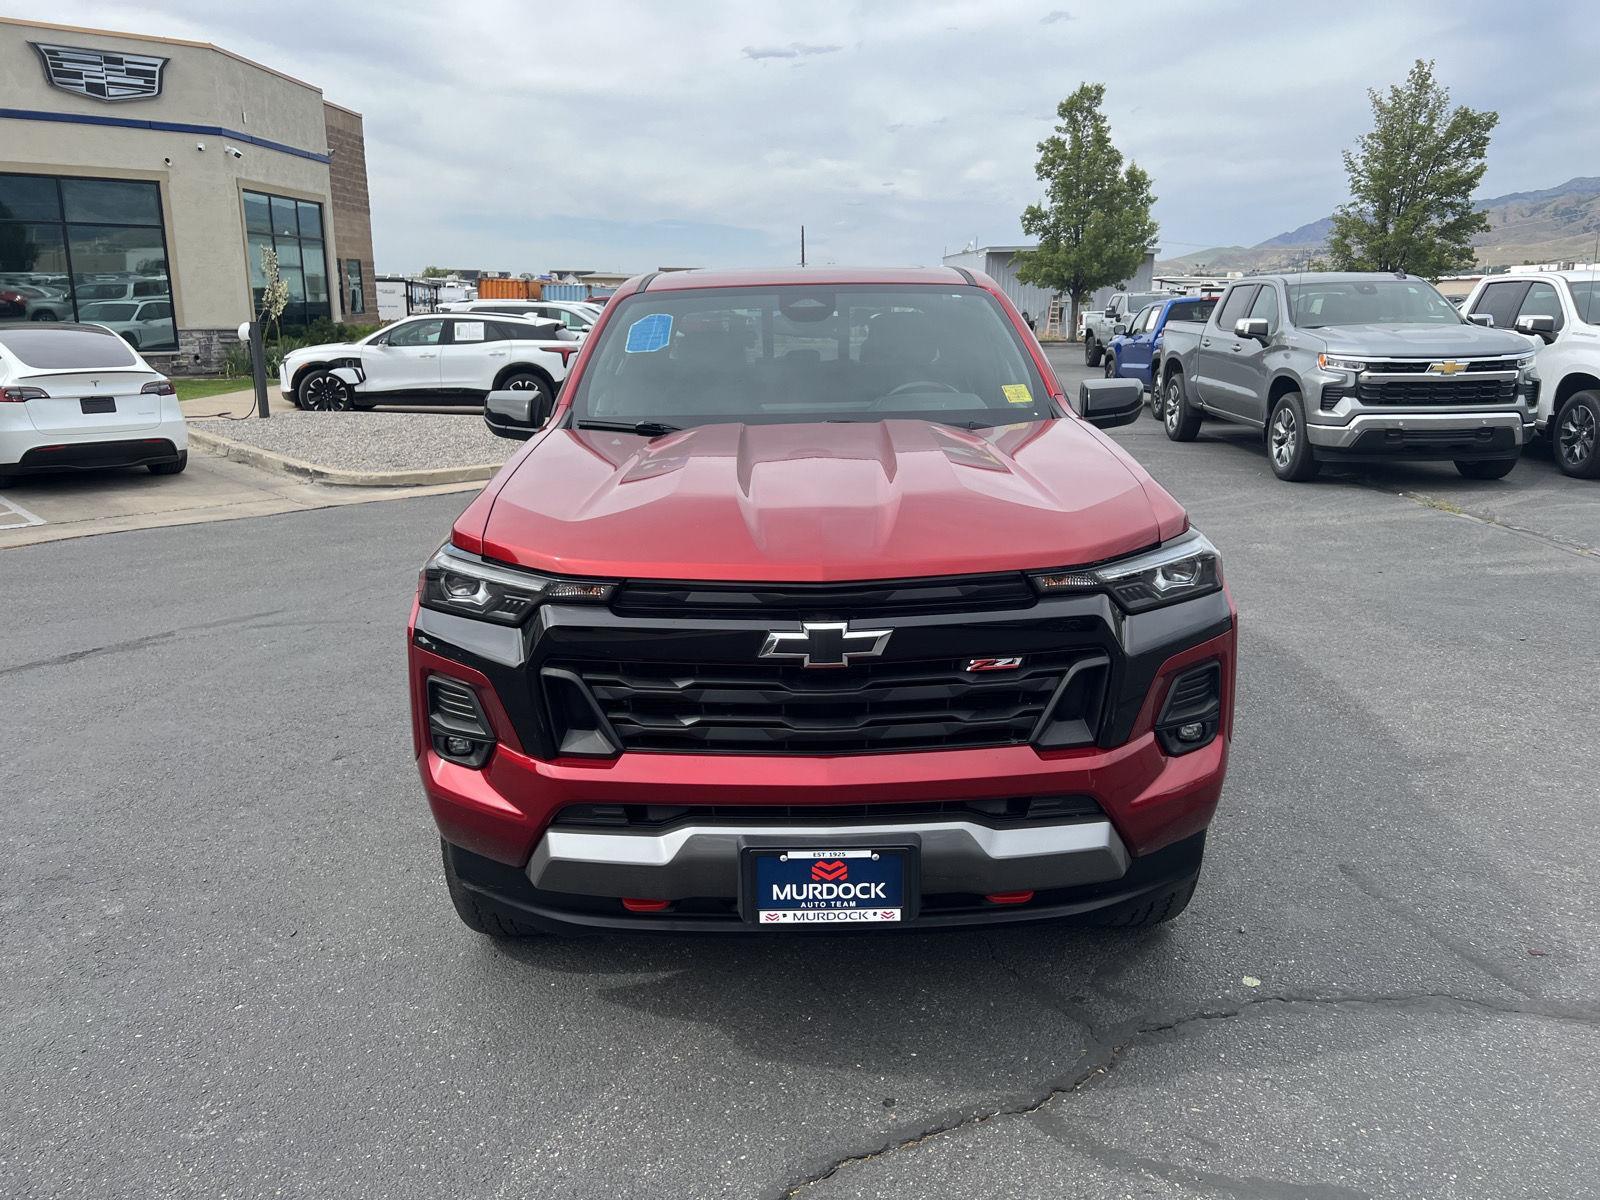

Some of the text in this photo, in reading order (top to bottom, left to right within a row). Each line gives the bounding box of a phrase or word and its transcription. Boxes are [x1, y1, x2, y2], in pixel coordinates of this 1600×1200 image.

[966, 657, 1022, 671] Z71
[772, 882, 887, 900] MURDOCK
[792, 911, 869, 921] MURDOCK
